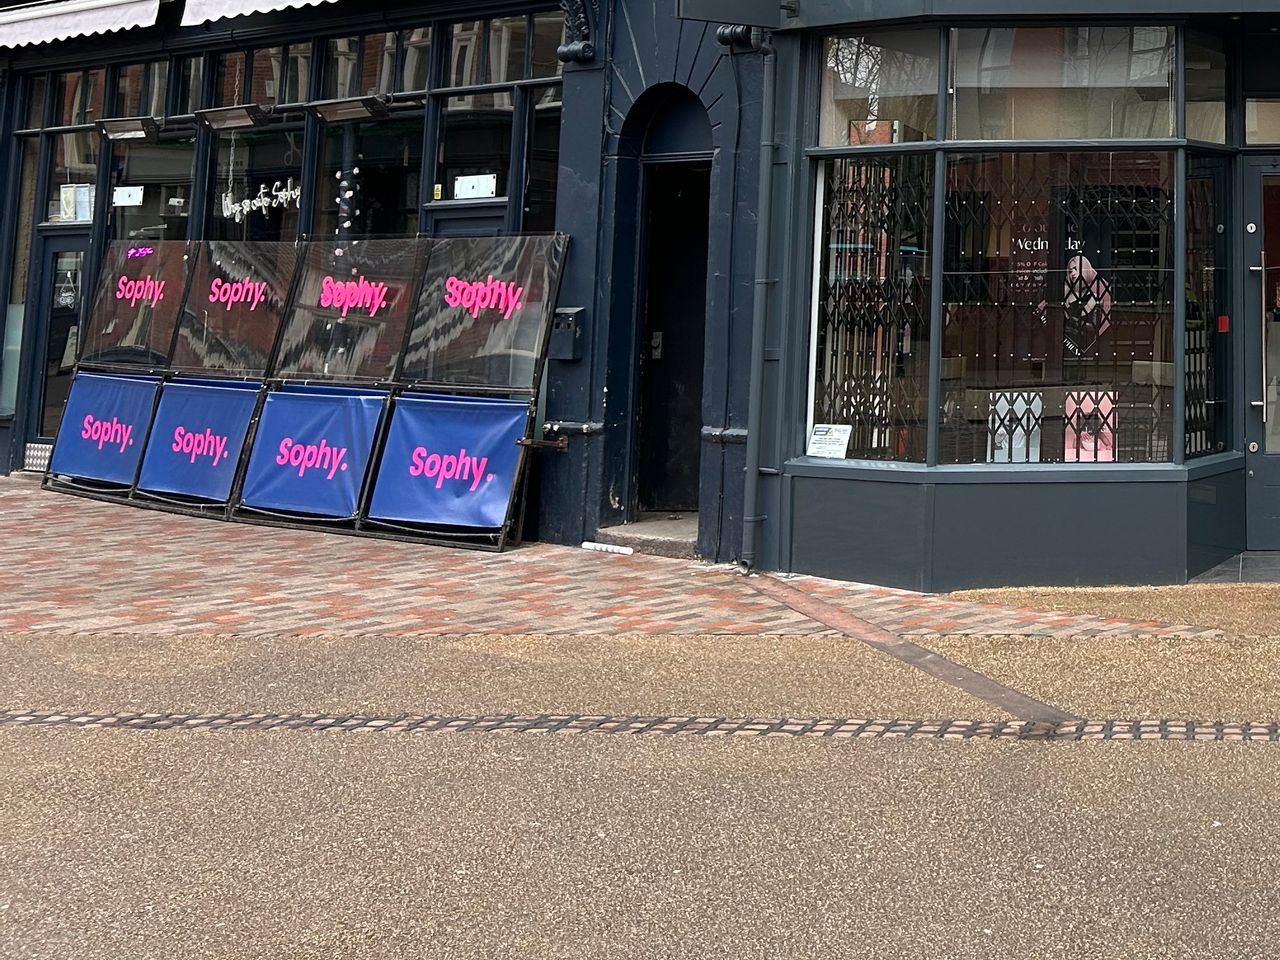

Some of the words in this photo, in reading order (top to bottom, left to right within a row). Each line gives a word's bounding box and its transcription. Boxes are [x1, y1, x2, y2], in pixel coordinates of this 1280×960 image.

[1012, 236, 1086, 253] Wednday
[116, 274, 166, 308] Sophy.
[208, 276, 268, 311] Sophy.
[320, 275, 389, 318] Sophy.
[444, 274, 524, 320] Sophy.
[81, 414, 134, 453] Sophy.
[171, 426, 229, 467] Sophy.
[276, 437, 348, 480] Sophy.
[409, 446, 496, 492] Sophy.
